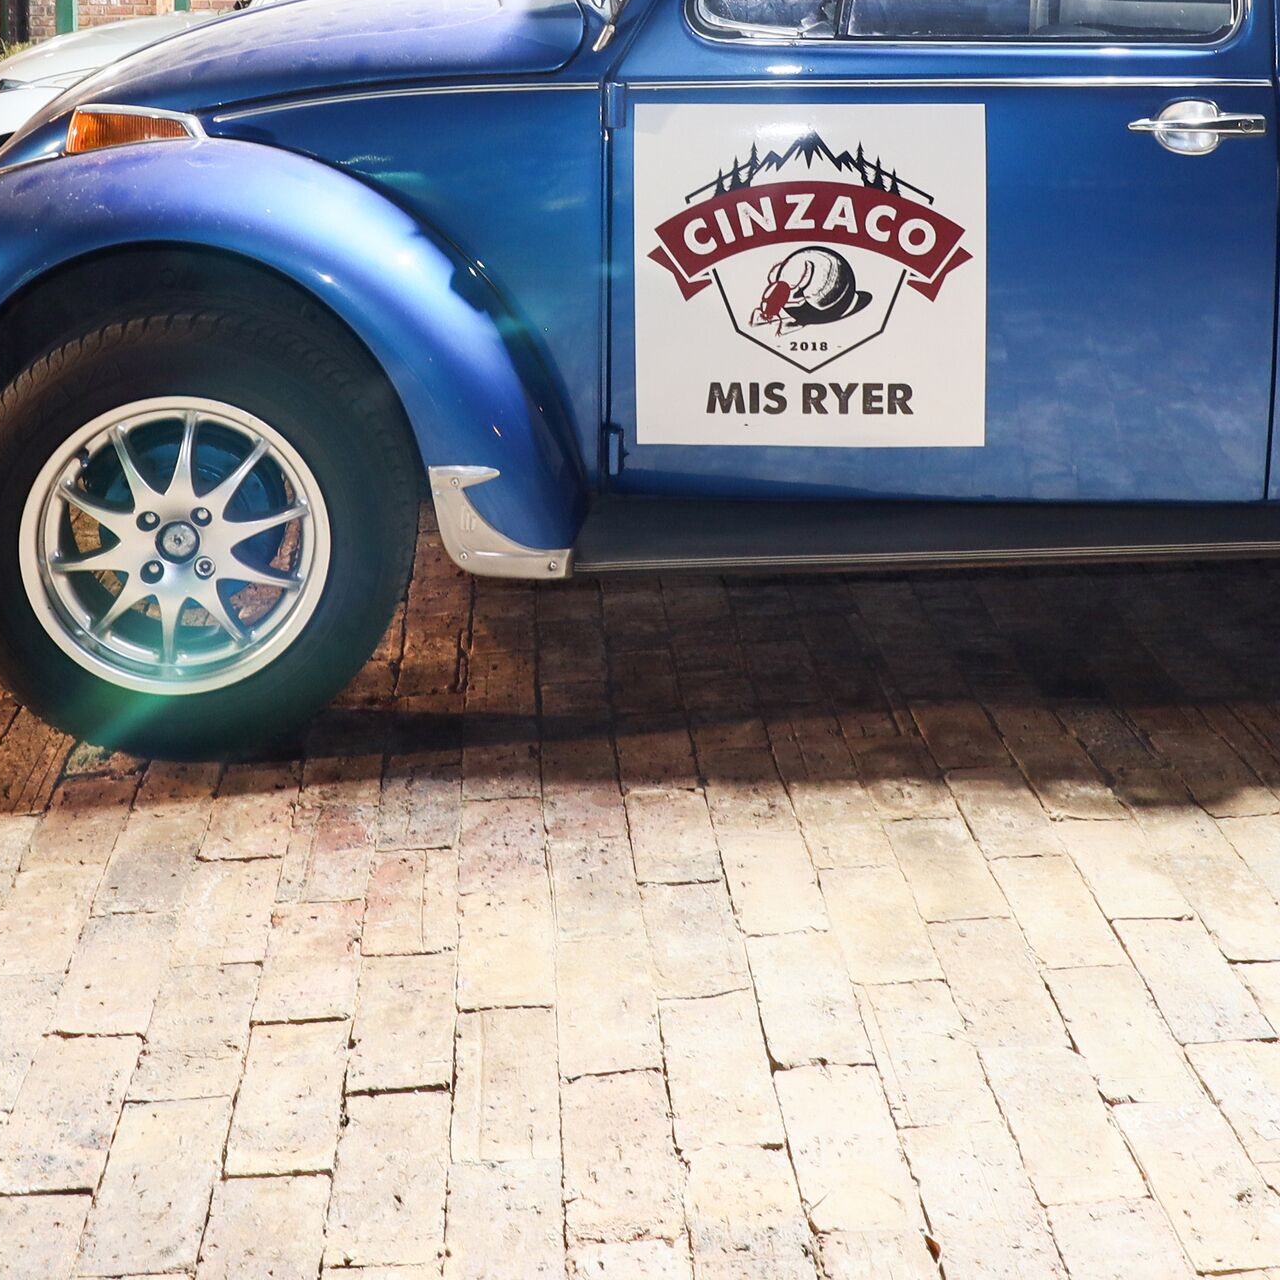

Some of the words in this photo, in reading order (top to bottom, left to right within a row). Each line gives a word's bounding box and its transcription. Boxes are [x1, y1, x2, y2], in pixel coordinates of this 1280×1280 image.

[682, 192, 937, 257] CINZACO
[789, 340, 829, 353] 2018
[705, 381, 788, 415] MIS
[801, 382, 914, 416] RYER
